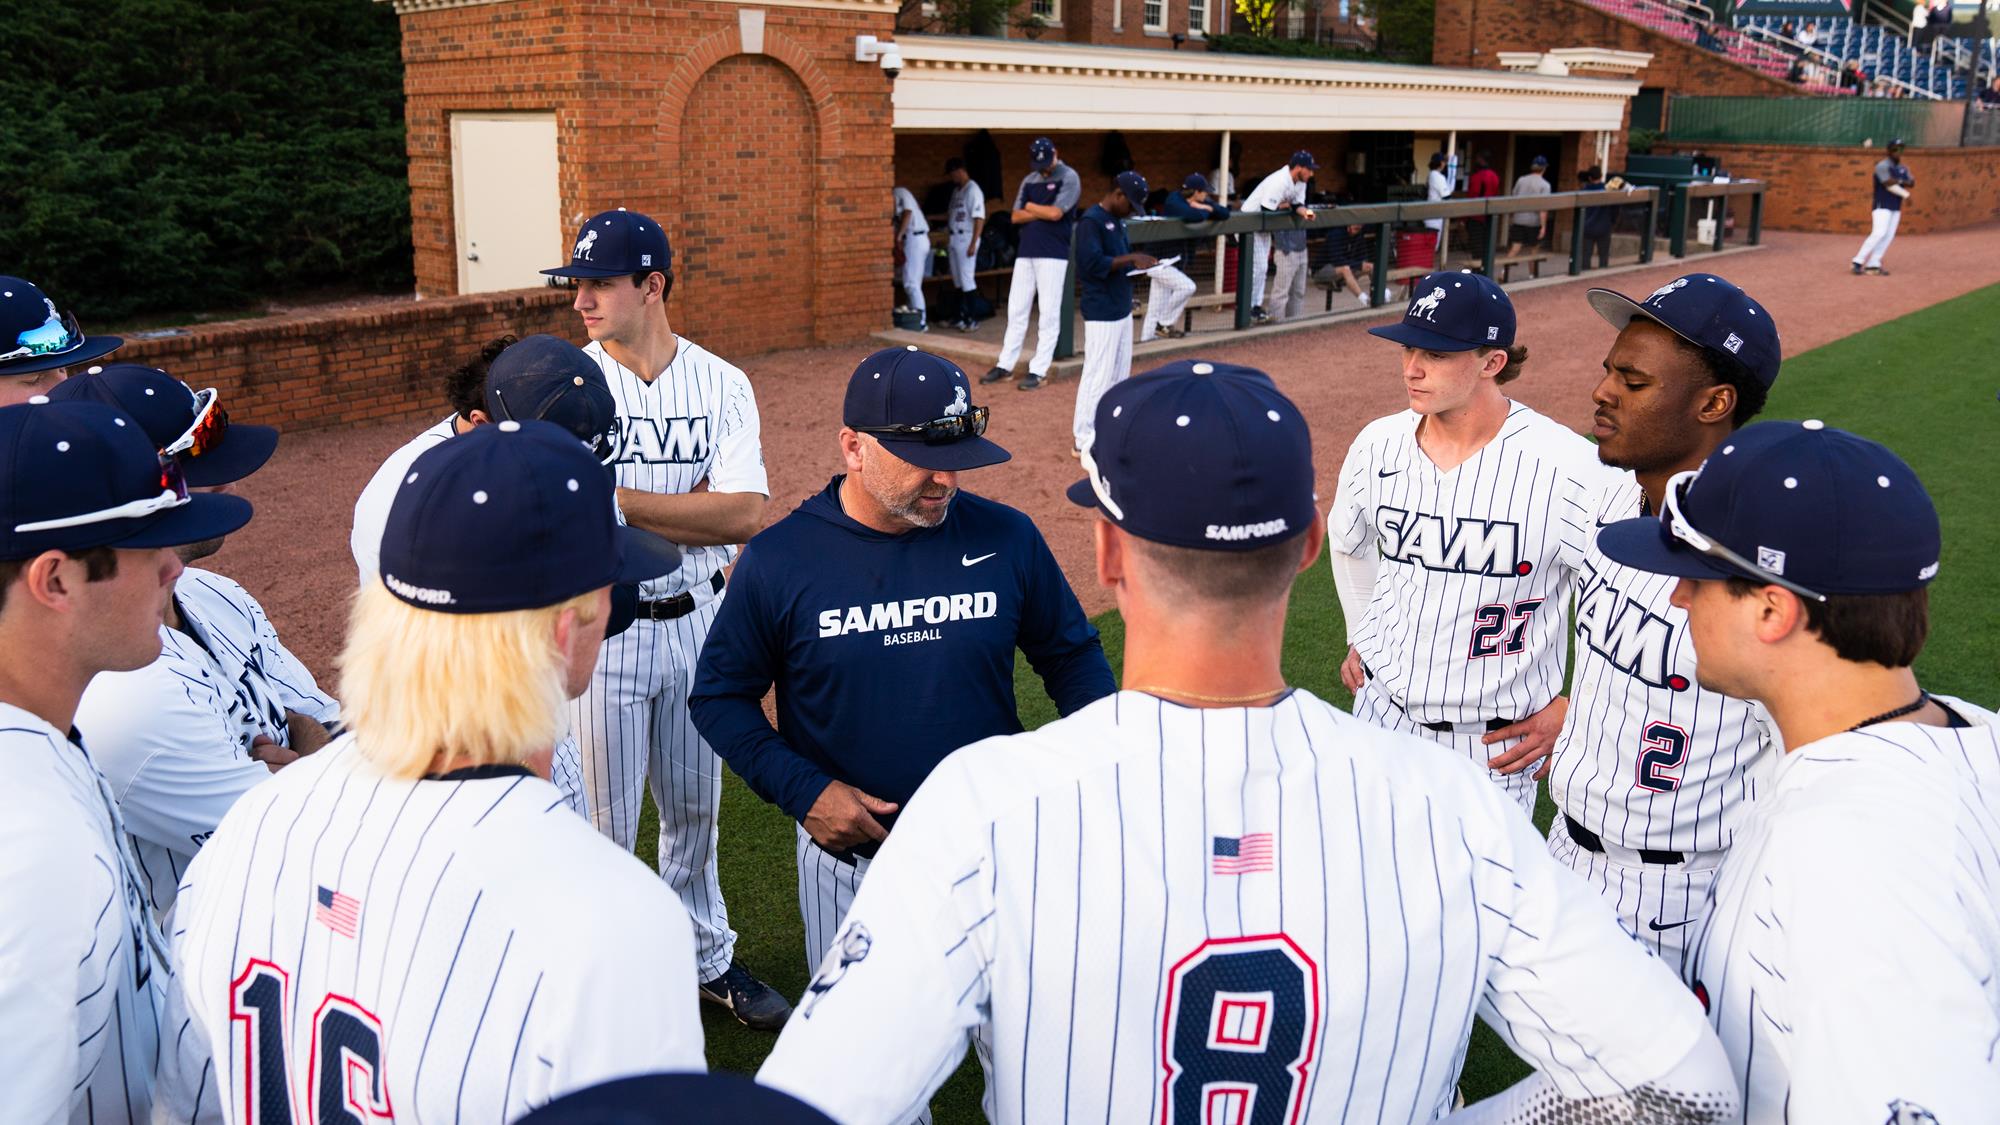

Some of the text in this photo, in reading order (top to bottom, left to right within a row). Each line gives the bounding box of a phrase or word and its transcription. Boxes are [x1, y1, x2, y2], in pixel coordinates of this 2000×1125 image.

[1205, 518, 1286, 540] SAMFORD
[1376, 505, 1532, 578] SAM.
[386, 574, 451, 604] SAMFORD
[819, 592, 997, 638] SAMFORD
[884, 628, 942, 646] BASEBALL
[1468, 598, 1546, 660] 27
[1636, 720, 1689, 793] 2
[1162, 932, 1319, 1125] 8
